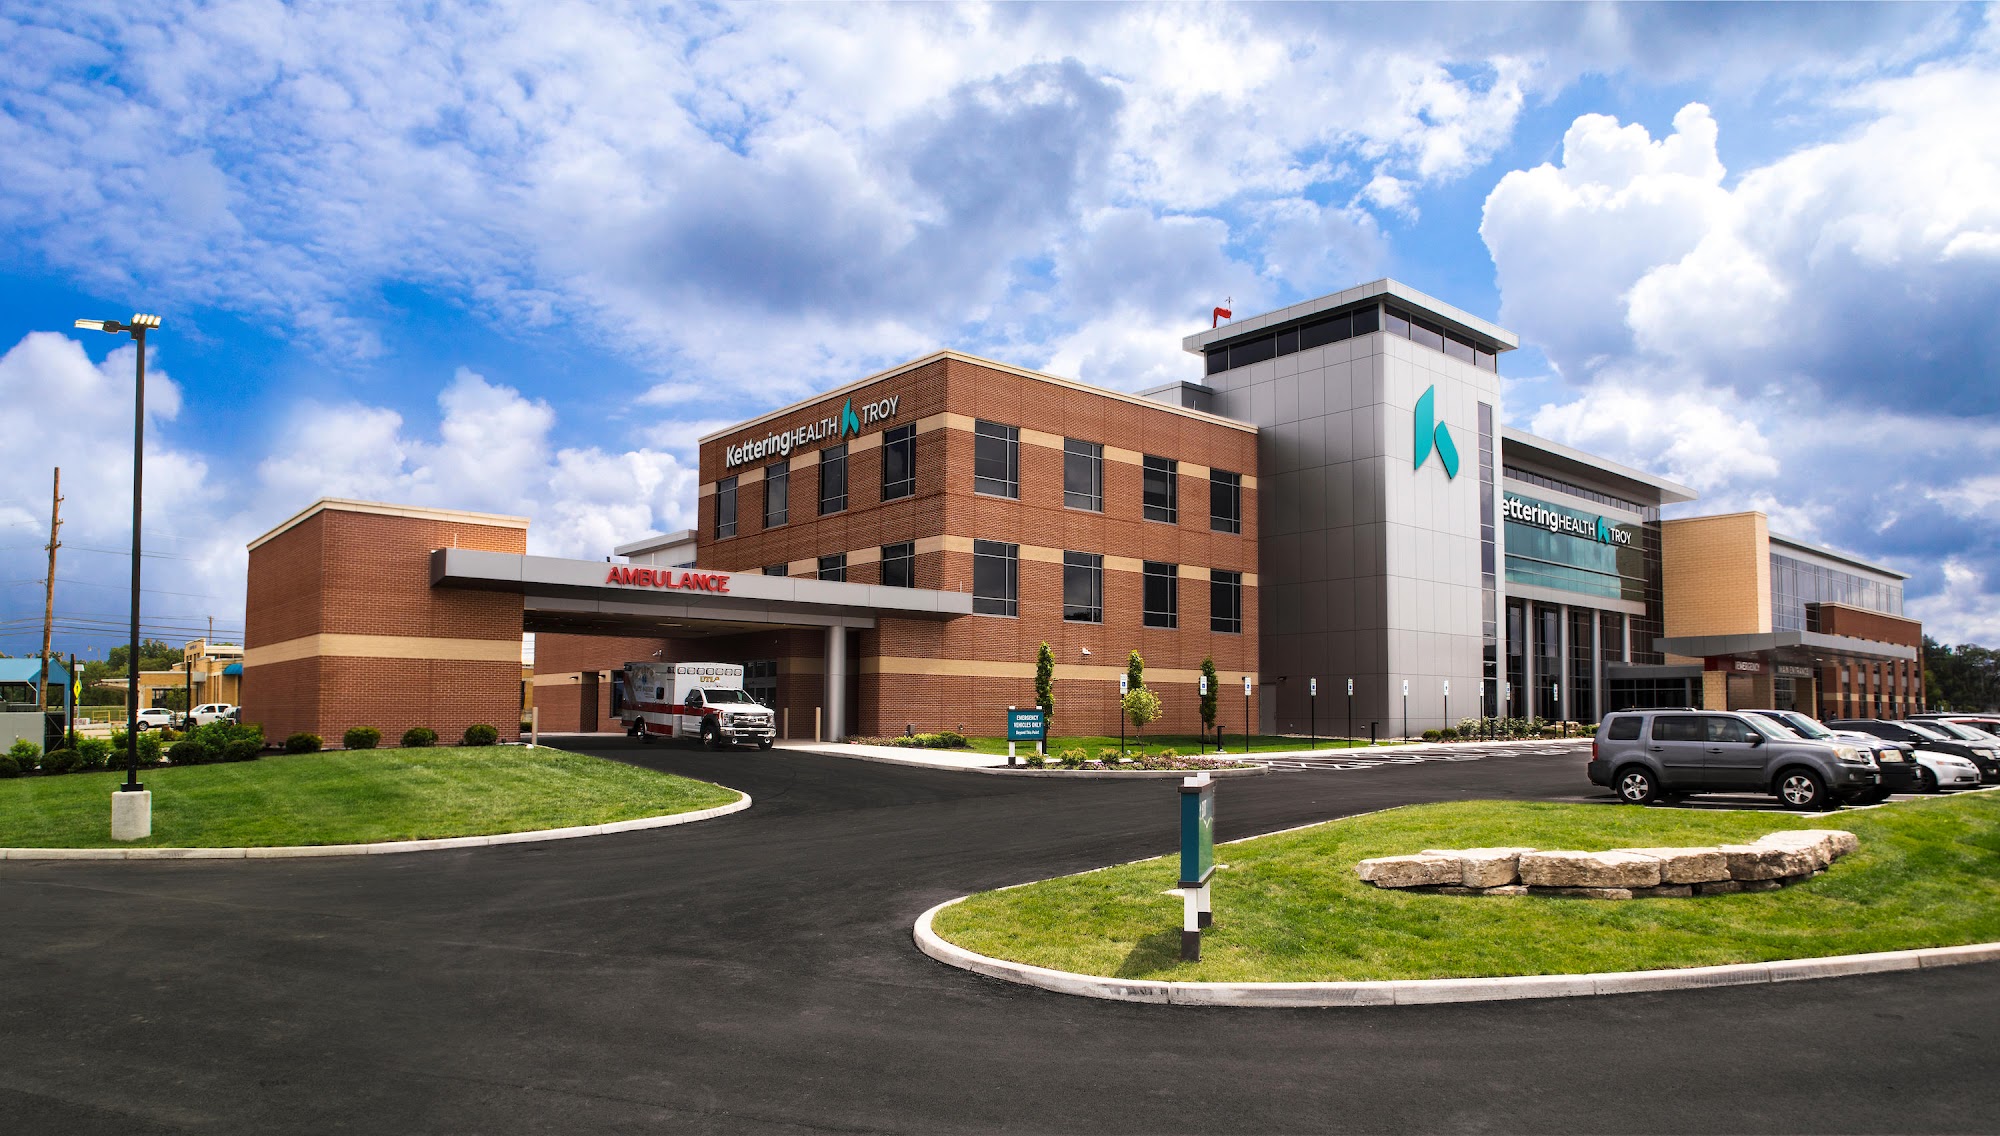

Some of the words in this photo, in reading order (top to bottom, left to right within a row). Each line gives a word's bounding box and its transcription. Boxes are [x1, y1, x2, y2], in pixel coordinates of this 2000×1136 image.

[862, 395, 899, 425] TROY
[1503, 496, 1596, 533] etteringHEALTH
[1610, 527, 1632, 545] TROY
[606, 566, 730, 592] AMBULANCE
